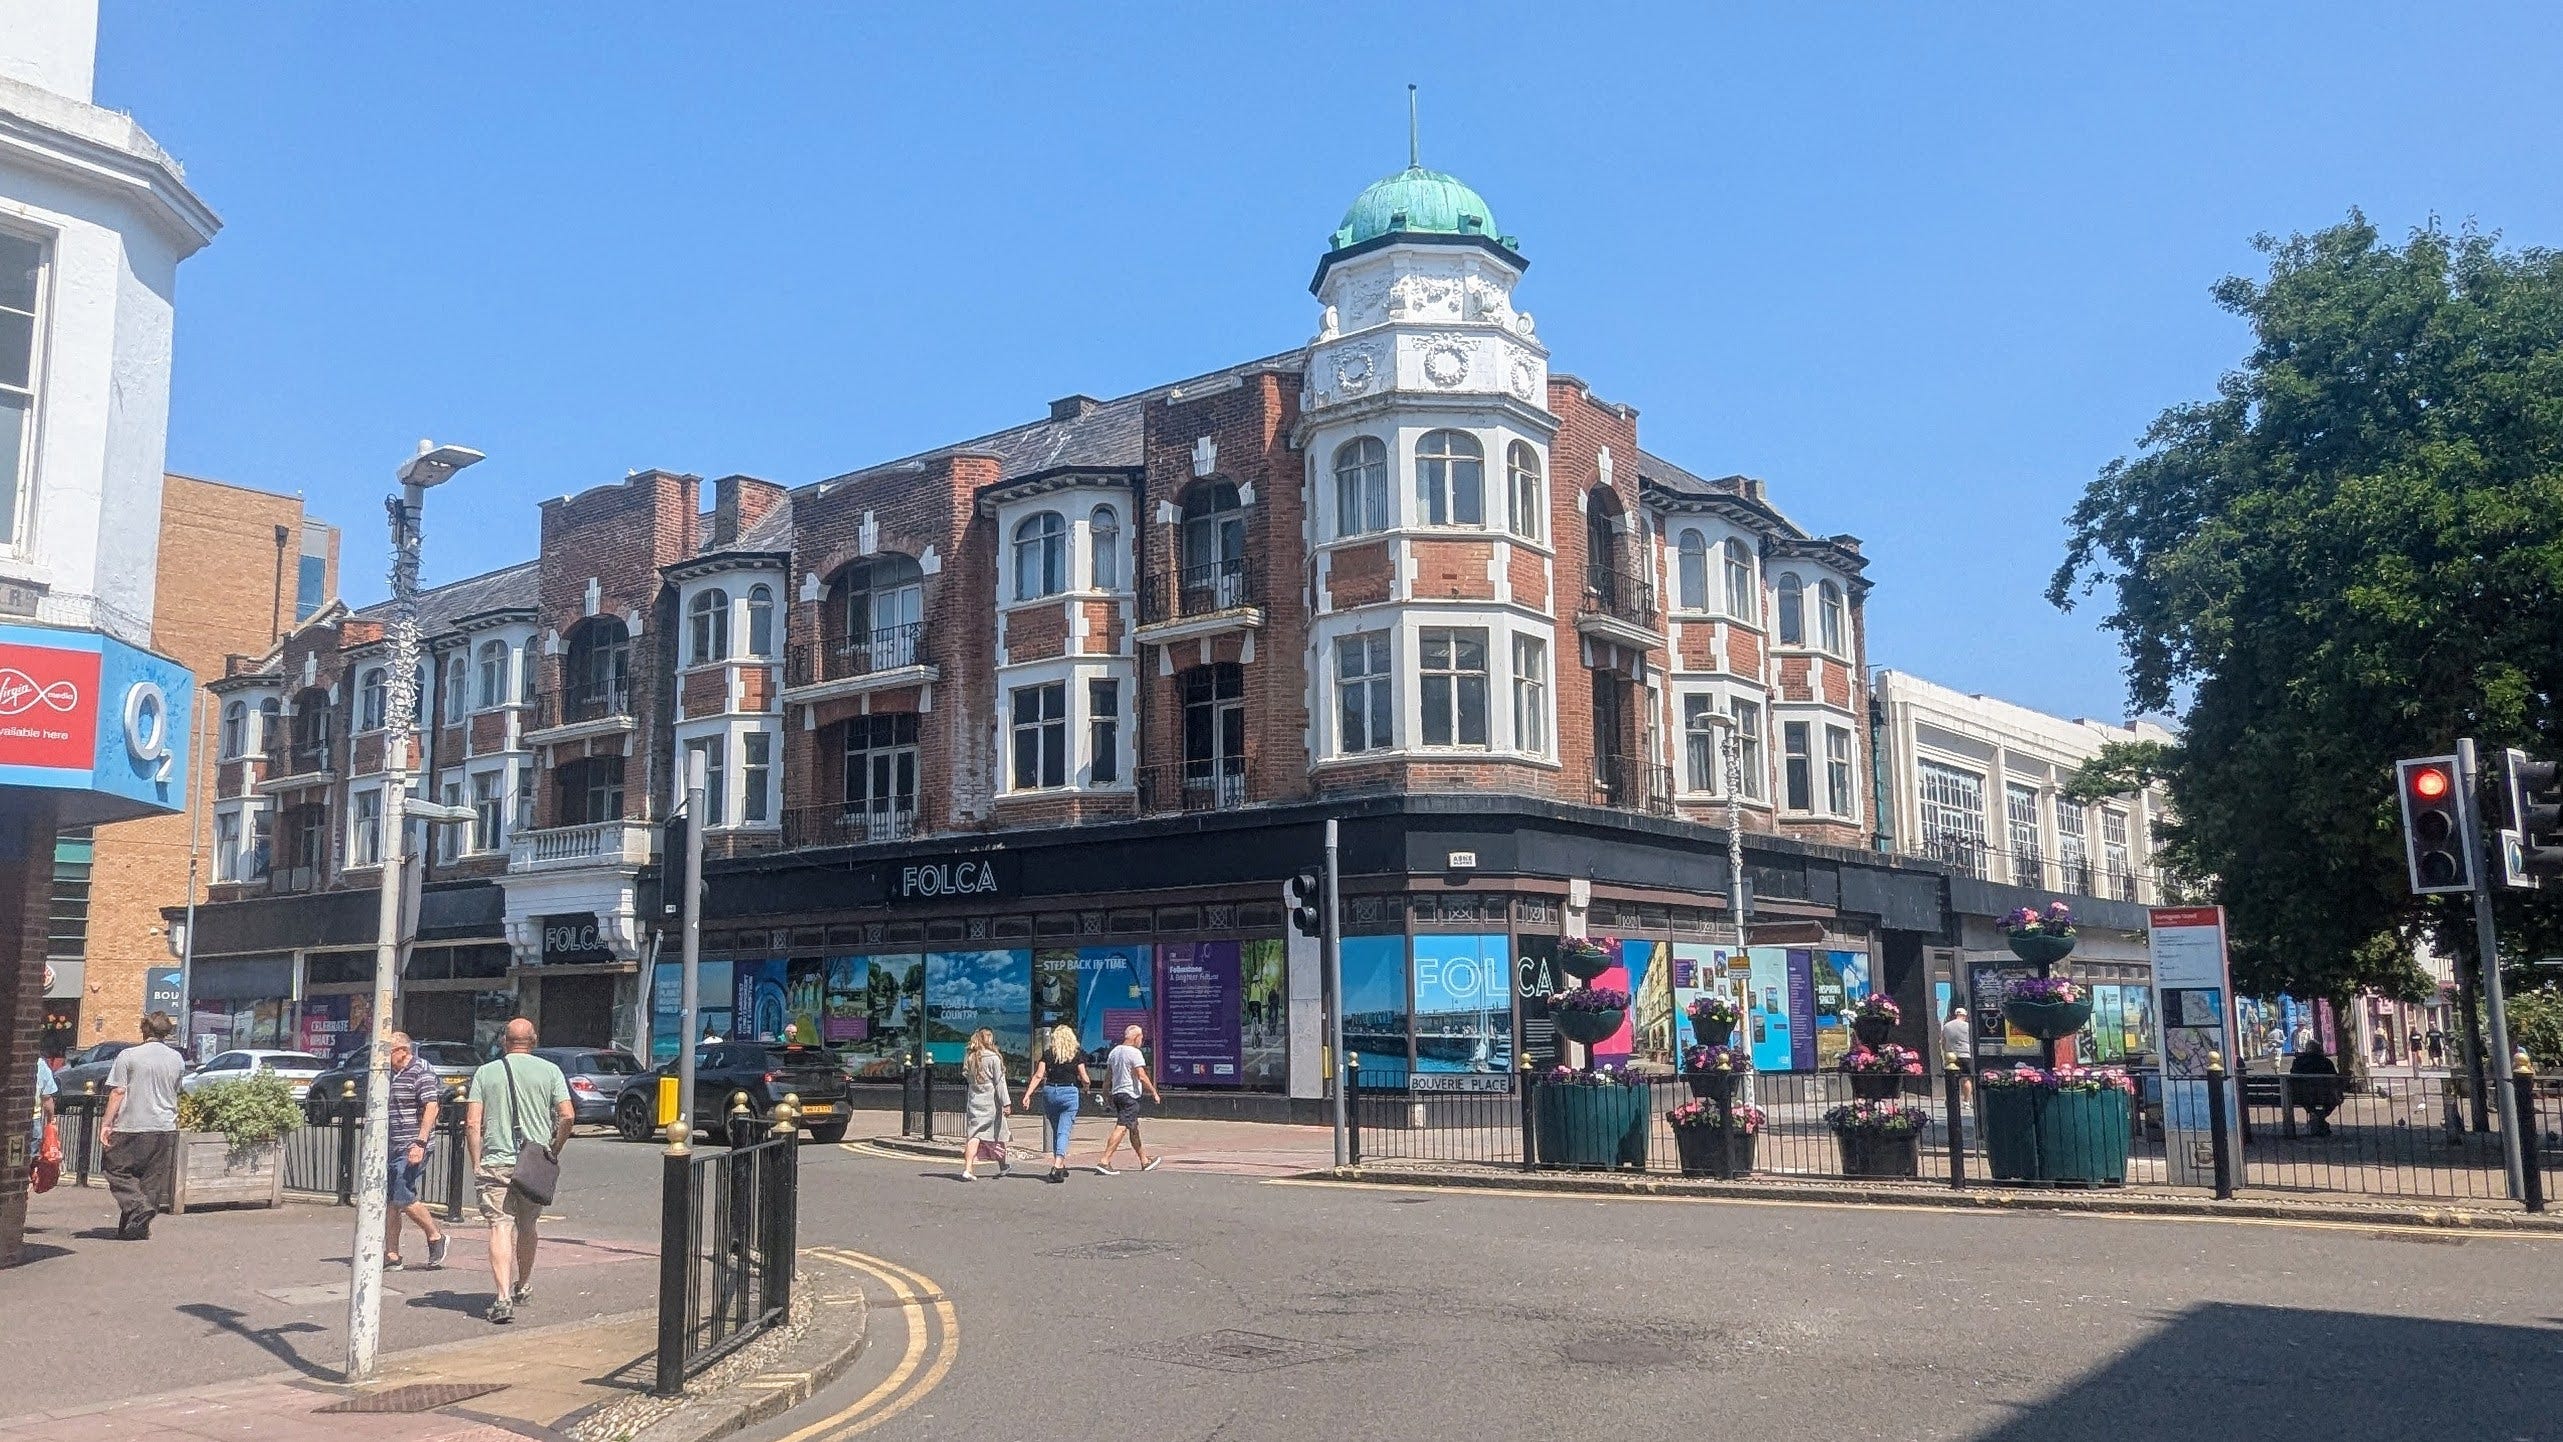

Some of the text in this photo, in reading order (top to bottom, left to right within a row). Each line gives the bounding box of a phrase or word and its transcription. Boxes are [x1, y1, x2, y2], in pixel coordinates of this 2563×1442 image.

[47, 692, 74, 700] media
[43, 729, 69, 740] here
[903, 860, 998, 897] FOLCA
[1043, 958, 1127, 971] STEP BACK IN TIME
[940, 1010, 978, 1020] COUNTRY
[310, 1020, 349, 1032] CELEBRATE
[310, 1034, 336, 1047] WHAT'S
[1411, 1078, 1507, 1092] BOUVERIE PLACE
